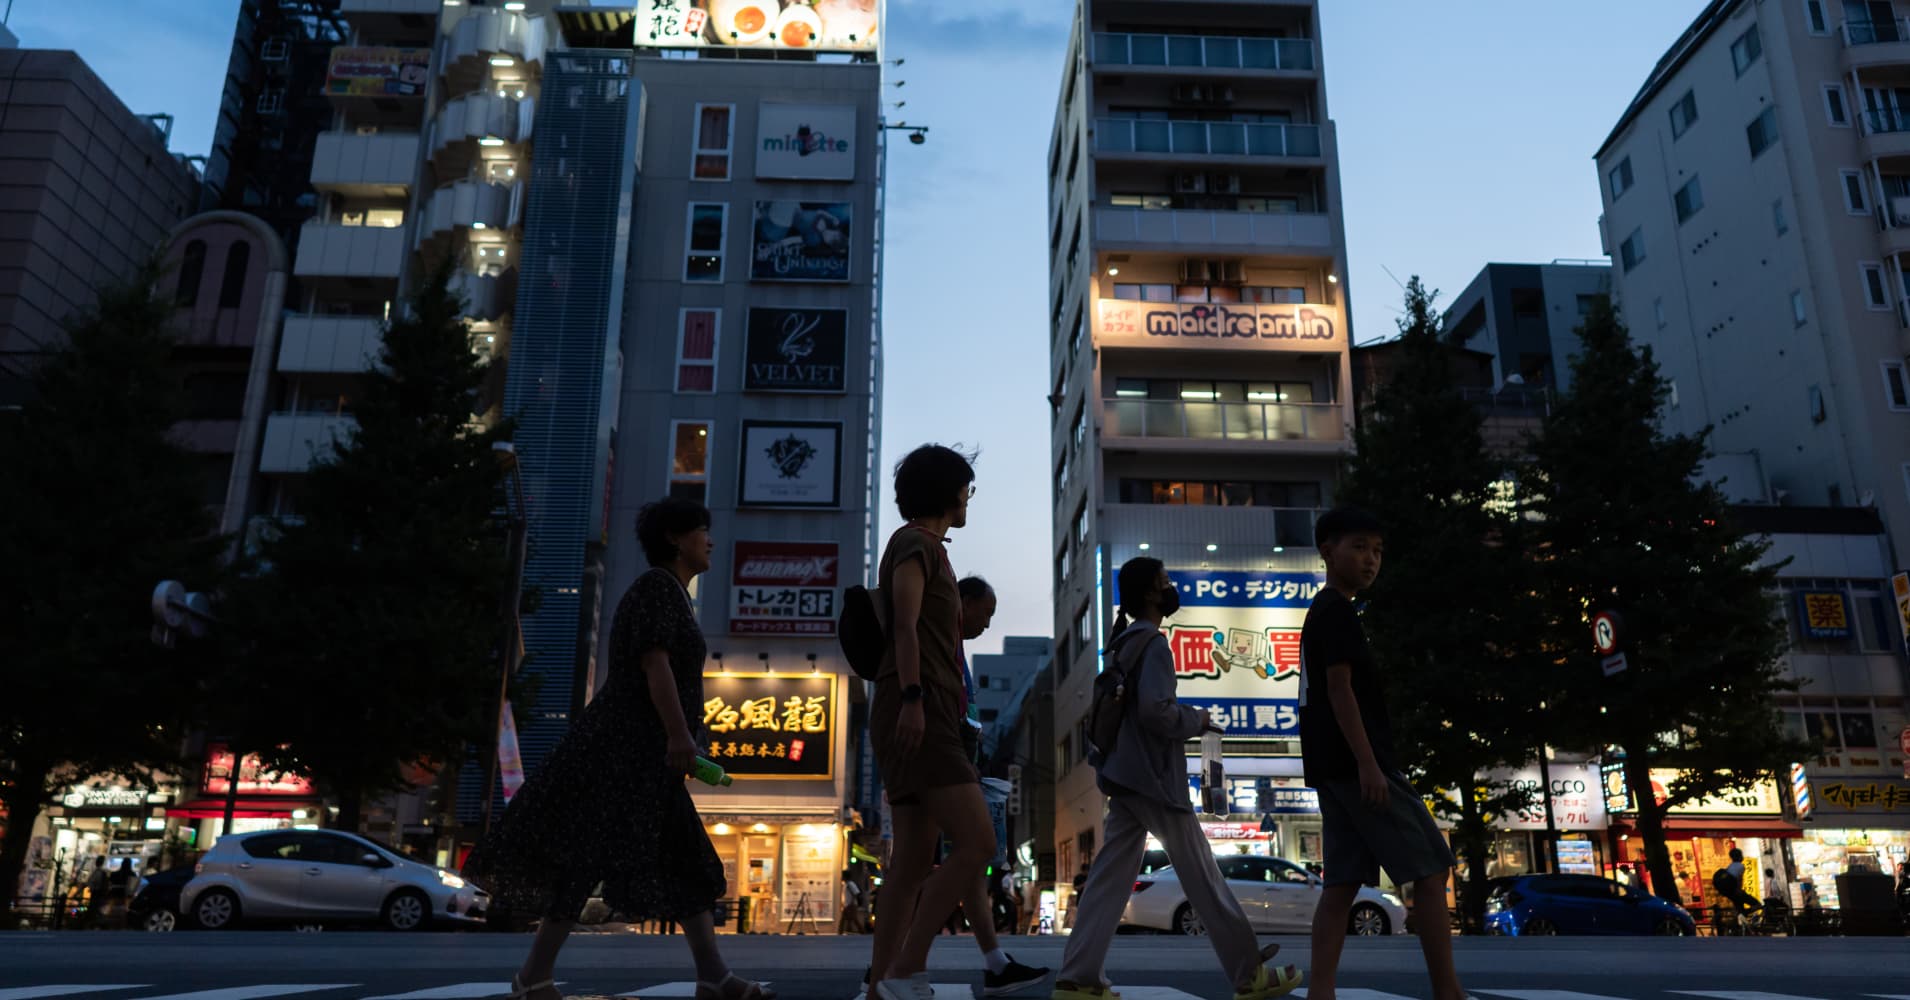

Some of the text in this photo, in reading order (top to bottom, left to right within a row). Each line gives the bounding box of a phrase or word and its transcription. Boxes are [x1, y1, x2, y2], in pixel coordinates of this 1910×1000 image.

[1104, 310, 1134, 320] メイド
[1147, 306, 1334, 339] maidreamin
[1104, 321, 1135, 332] カフェ
[751, 363, 842, 381] VELVET
[739, 589, 796, 604] トレカ
[1171, 579, 1325, 601] ・PC・デジタル
[801, 592, 832, 615] 3F
[1809, 595, 1843, 626] 薬
[1505, 779, 1585, 794] TOBCCO
[1518, 812, 1590, 824] コロックル
